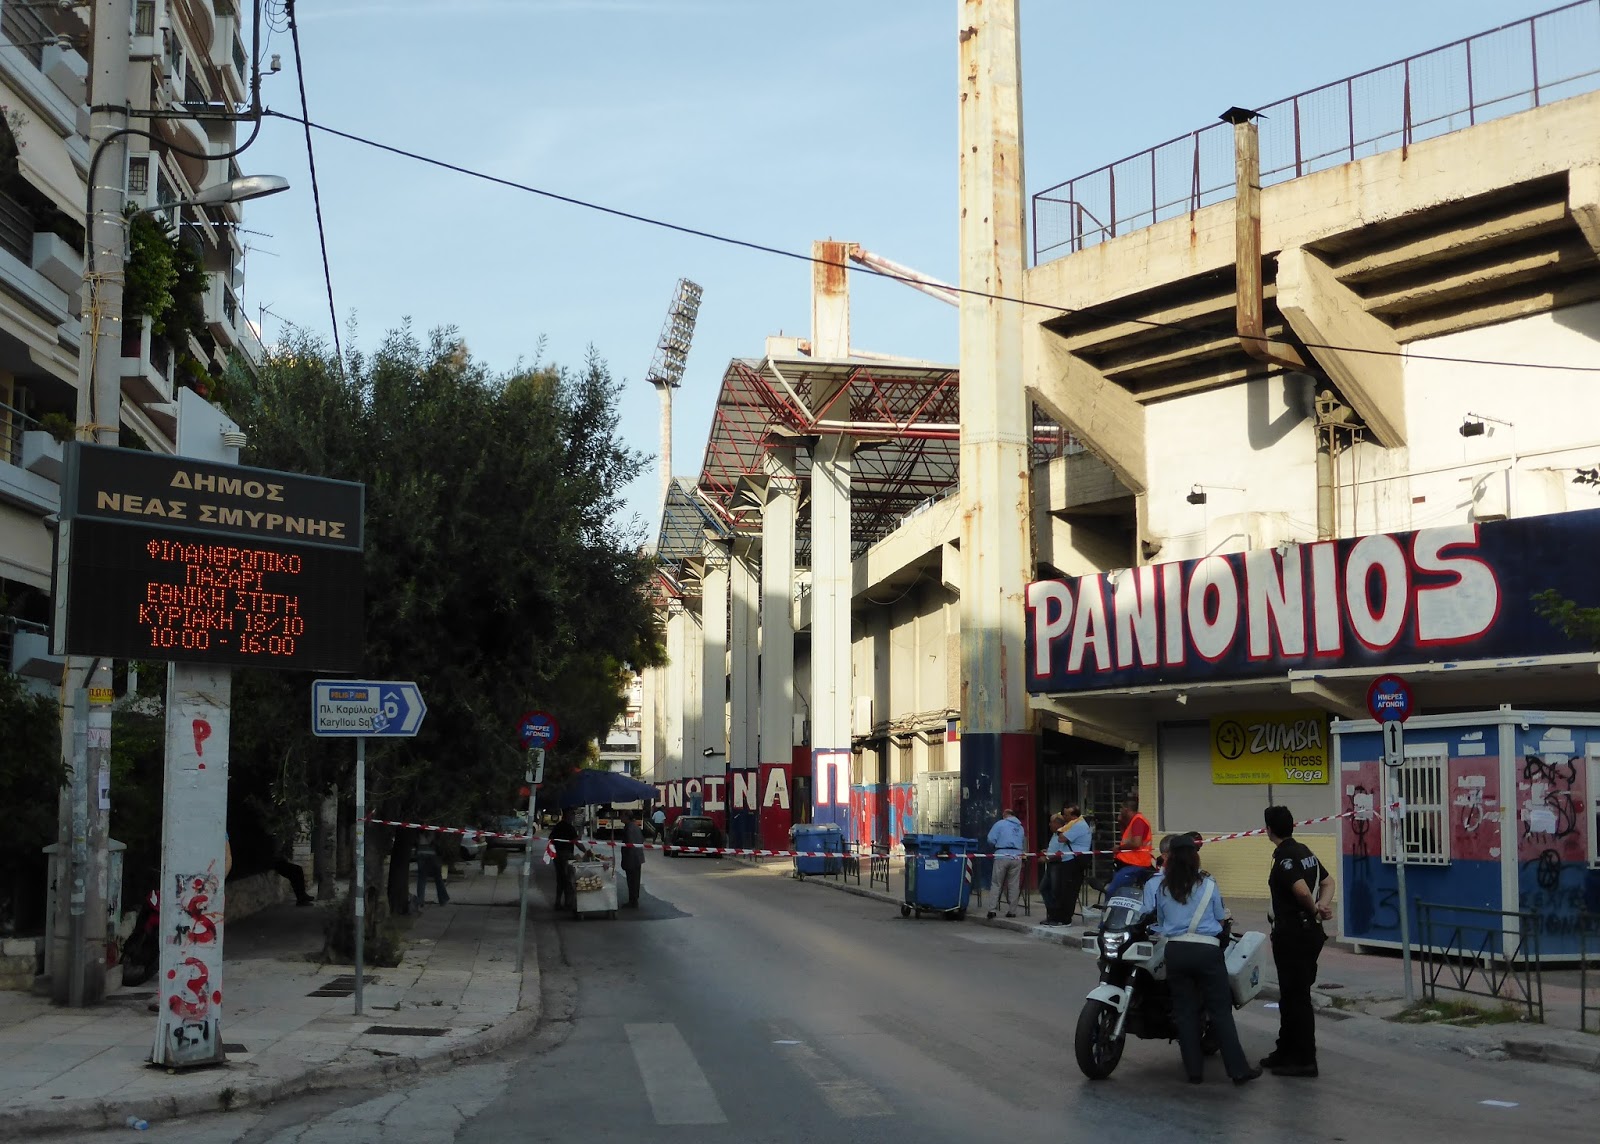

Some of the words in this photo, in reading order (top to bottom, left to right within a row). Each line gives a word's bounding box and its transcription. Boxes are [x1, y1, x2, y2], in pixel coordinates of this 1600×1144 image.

[170, 470, 284, 502] ΔΗΜΟΣ
[97, 490, 187, 520] ΝΕΑΣ
[199, 504, 346, 540] ΣΜΥΡΝΗΣ
[146, 539, 301, 574] ΦΙΛΑΝΘΡΩΠΙΚΟ
[186, 564, 264, 591] ΠΑΖΑΡΙ
[147, 582, 225, 609] ΕΘΝΙΚΗ
[235, 590, 299, 615] ΣΤΕΓΗ
[1027, 523, 1500, 677] PANIONIOS
[139, 603, 233, 631] ΚΥΡΙΑΚΗ
[245, 612, 304, 636] 18/10
[151, 626, 210, 650] 10:00
[239, 633, 295, 656] 16:00
[320, 705, 334, 714] Πλ.
[336, 704, 378, 716] Καρύλλου
[1377, 693, 1404, 701] ΗΜΕΡΕΣ
[1377, 700, 1405, 708] ΑΓΩΝΩΝ
[320, 717, 356, 728] Karyllou
[525, 730, 550, 738] ΑΓΩΝΩΝ
[1247, 719, 1322, 754] ZUMBA
[1282, 752, 1322, 767] fitness
[1285, 768, 1322, 782] Yoga
[1112, 900, 1135, 908] POLICE
